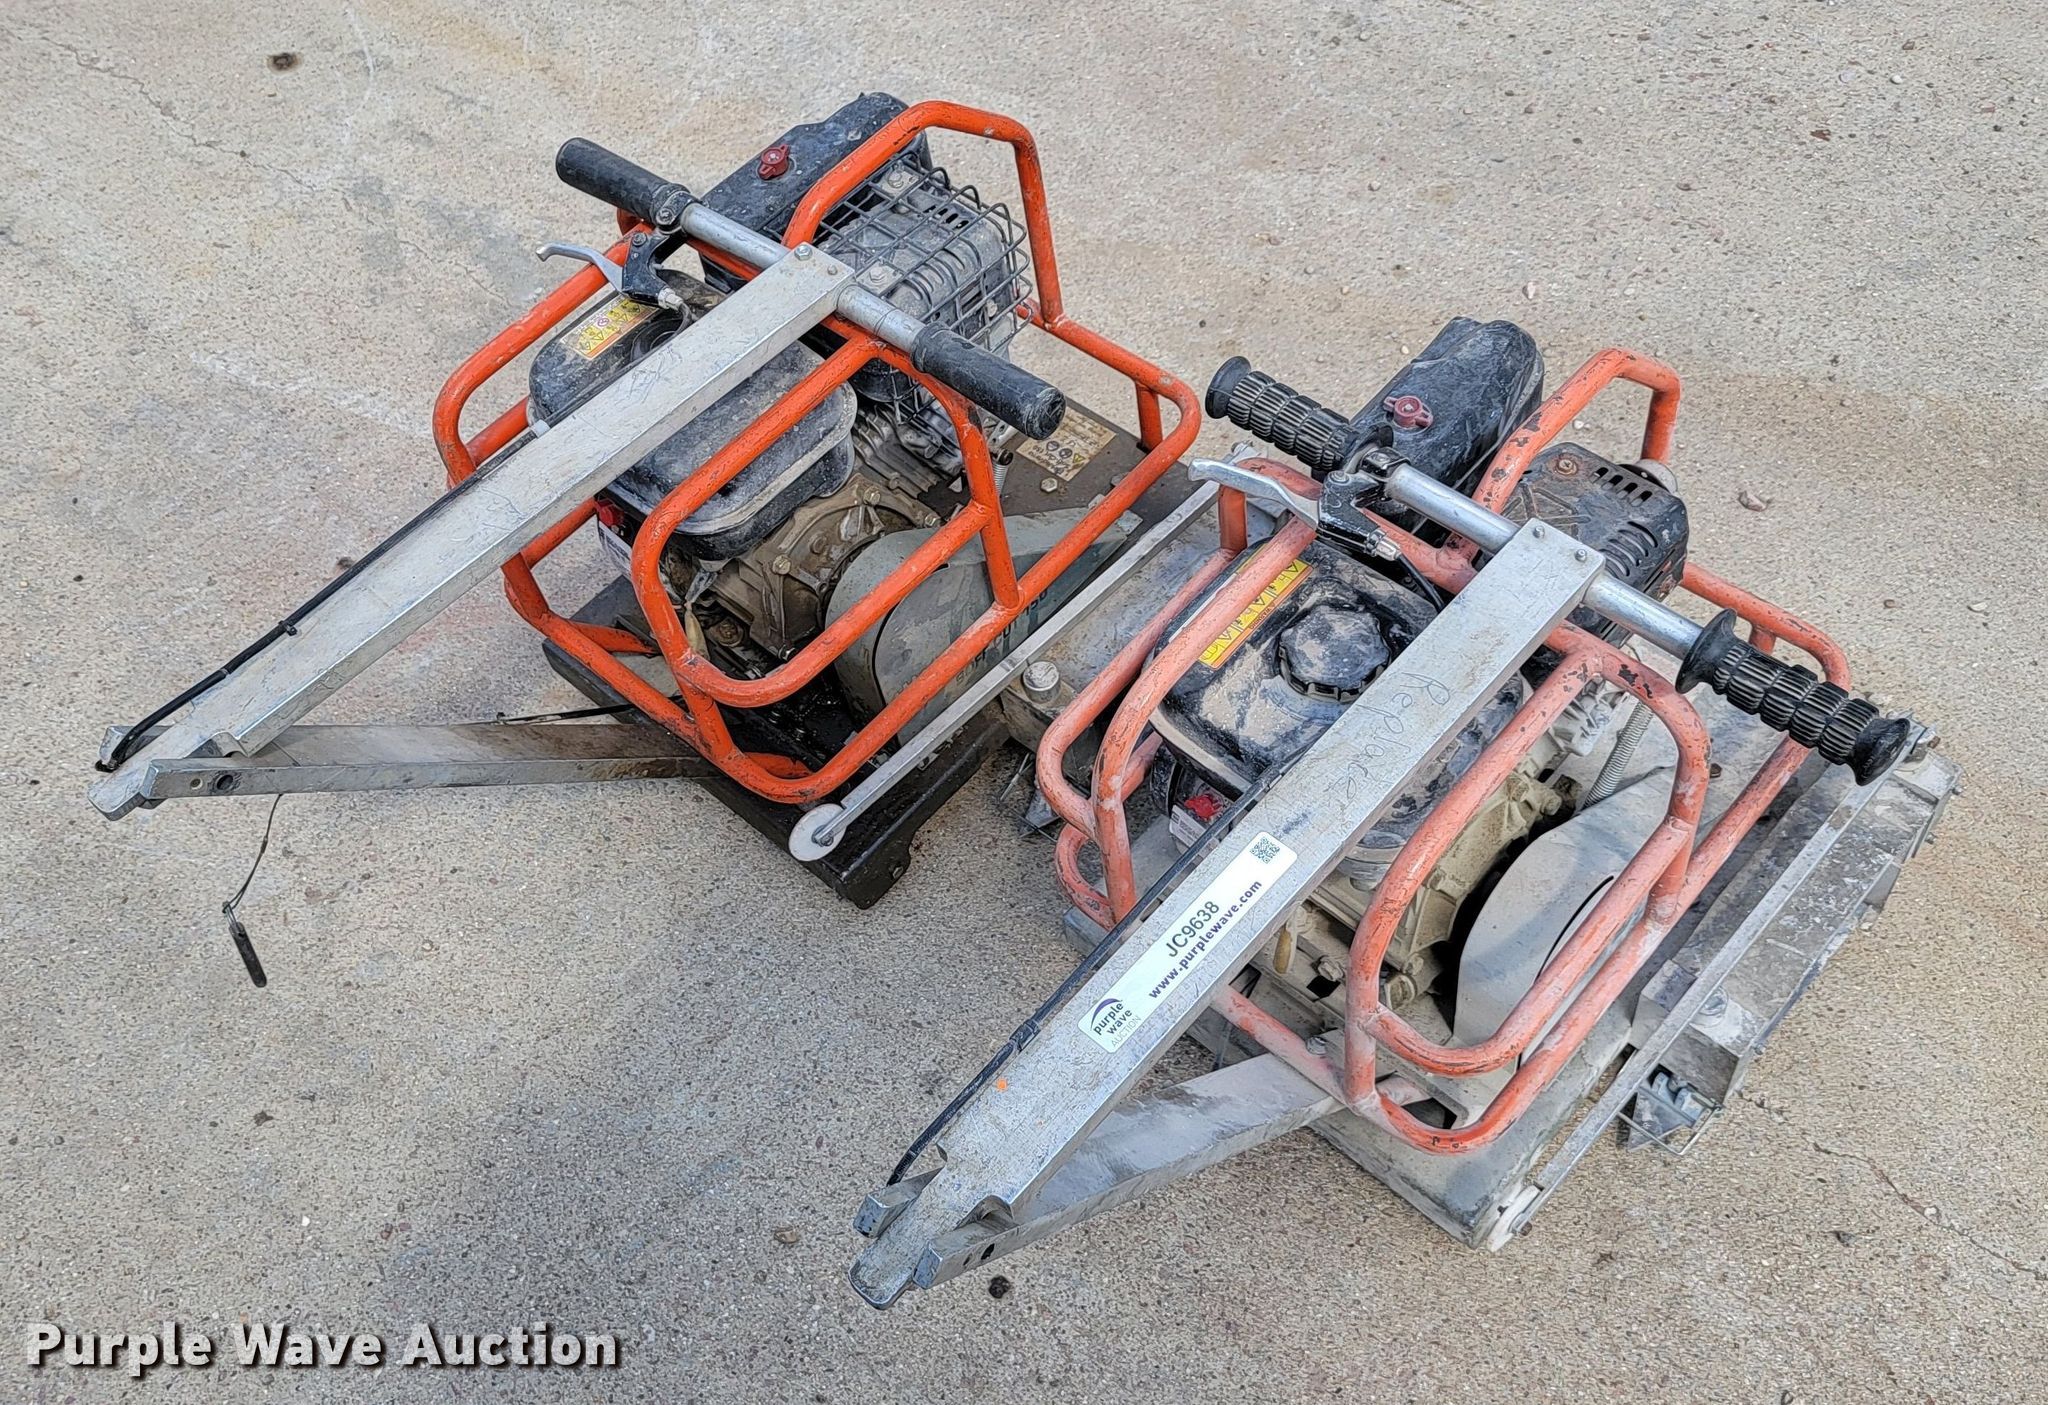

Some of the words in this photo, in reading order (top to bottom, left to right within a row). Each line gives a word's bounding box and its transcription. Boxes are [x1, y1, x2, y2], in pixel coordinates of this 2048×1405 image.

[1248, 607, 1271, 630] WARNING
[1149, 881, 1263, 999] www.purplewave.com
[1167, 901, 1220, 958] JC9638
[1093, 1002, 1124, 1035] purple
[1107, 1009, 1133, 1035] wave
[1111, 1016, 1142, 1048] AUCTION
